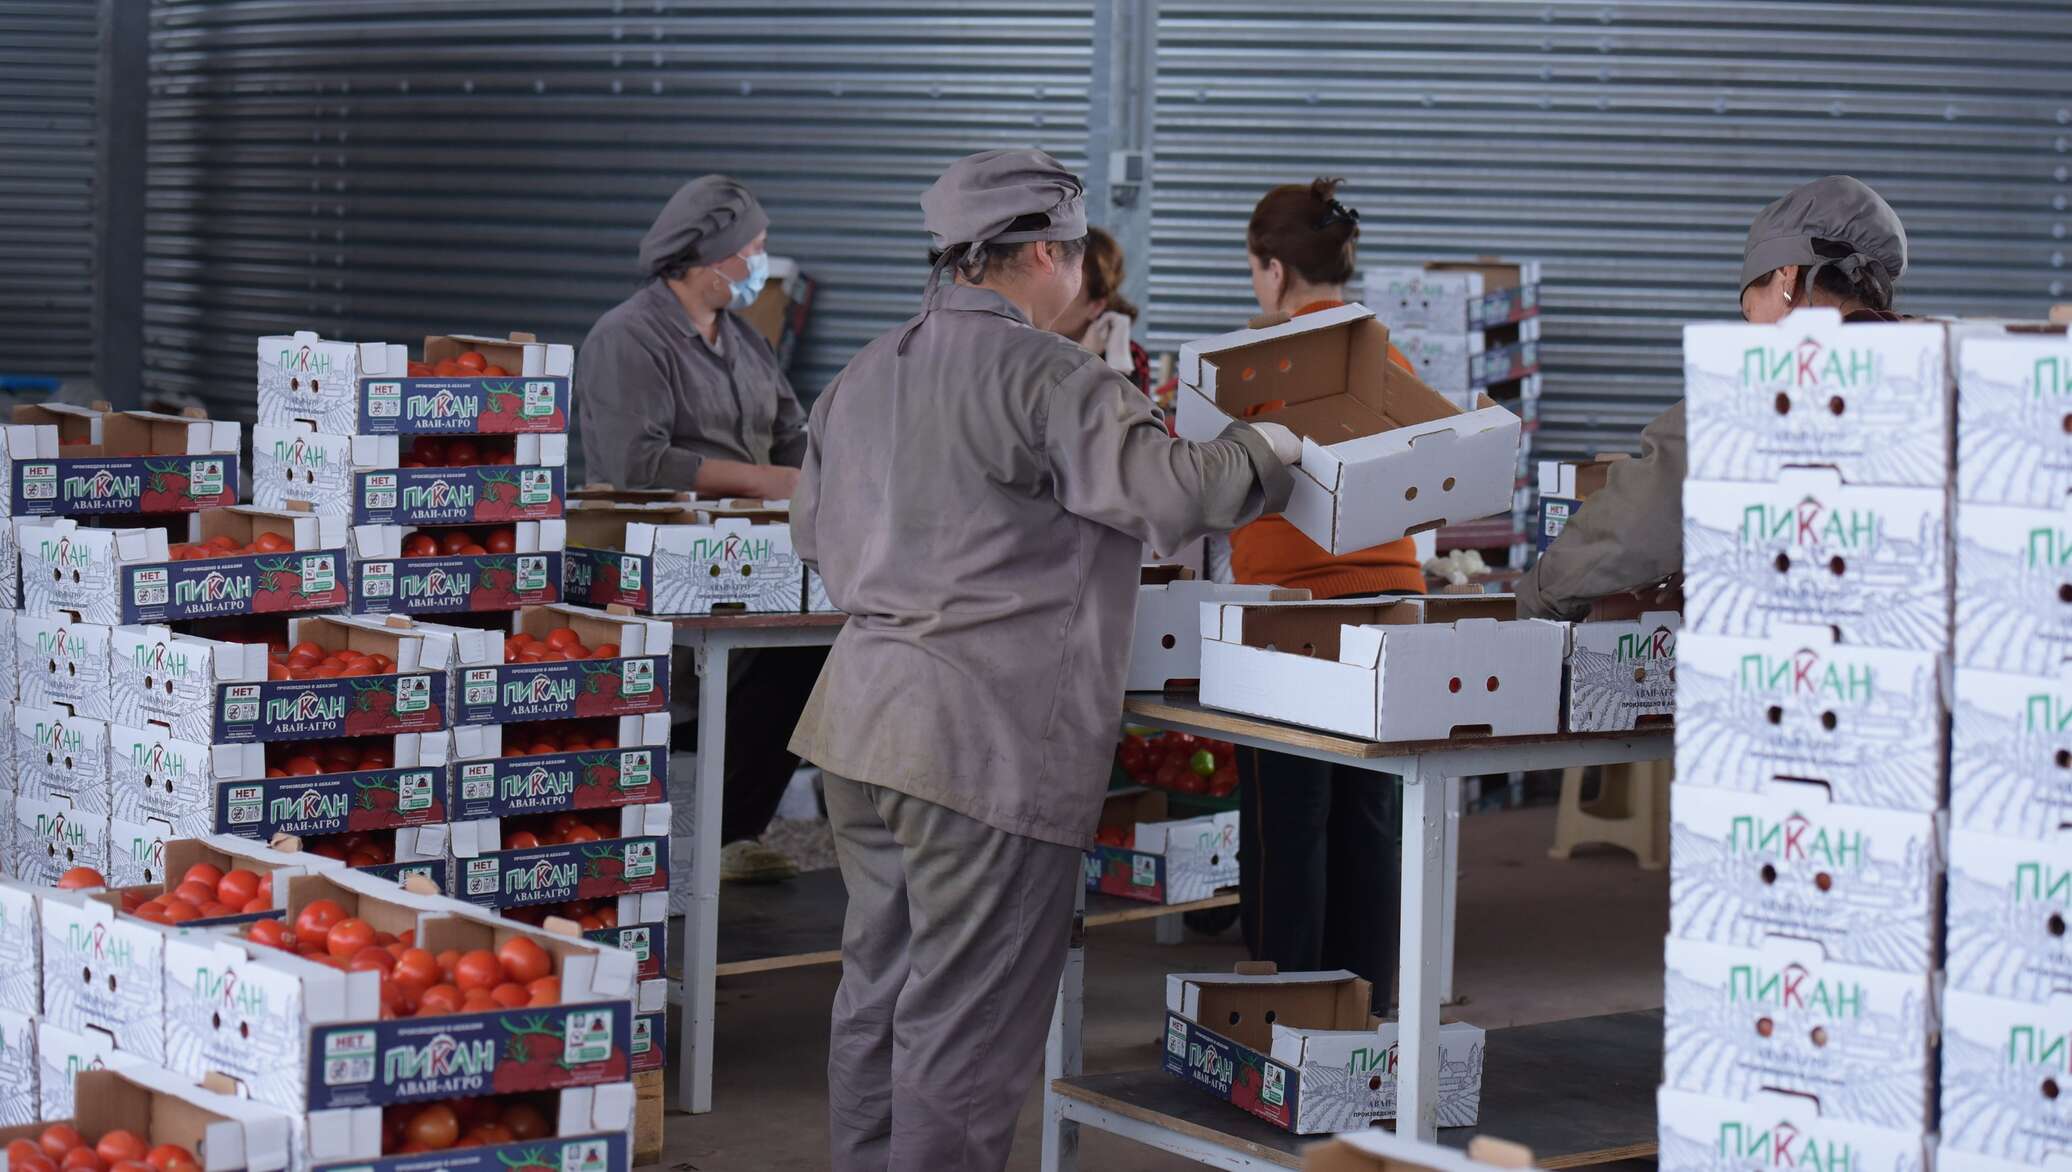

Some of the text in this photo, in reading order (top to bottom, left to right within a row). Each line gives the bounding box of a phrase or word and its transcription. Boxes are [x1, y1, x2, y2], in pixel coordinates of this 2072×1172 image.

[281, 350, 329, 374] ПИКАН
[1743, 348, 1873, 388] ПИКАН
[374, 385, 393, 394] НЕТ
[407, 394, 478, 421] ПИКАН
[275, 441, 323, 465] ПИКАН
[29, 467, 49, 476] НЕТ
[371, 476, 390, 485] НЕТ
[64, 474, 140, 501] ПИКАН
[403, 484, 474, 511] ПИКАН
[1743, 504, 1875, 547] ПИКАН
[41, 539, 89, 567] ПИКАН
[693, 538, 768, 561] ПИКАН
[140, 571, 160, 581] НЕТ
[368, 565, 387, 574] НЕТ
[175, 574, 251, 604] ПИКАН
[400, 572, 470, 600] ПИКАН
[38, 632, 85, 656] ПИКАН
[1618, 632, 1676, 663] ПИК
[136, 645, 186, 676] ПИКАН
[471, 671, 491, 680] НЕТ
[1741, 655, 1872, 699] ПИКАН
[232, 688, 254, 696] НЕТ
[504, 677, 576, 707] ПИКАН
[266, 695, 345, 725] ПИКАН
[36, 723, 81, 747] ПИКАН
[134, 744, 183, 776] ПИКАН
[468, 766, 488, 775] НЕТ
[235, 789, 257, 798] НЕТ
[501, 770, 574, 801] ПИКАН
[270, 792, 348, 825] ПИКАН
[37, 815, 84, 845] ПИКАН
[1198, 829, 1233, 849] ПИК
[1731, 816, 1861, 866] ПИКАН
[132, 838, 163, 868] ПИК
[474, 861, 493, 870] НЕТ
[506, 862, 578, 895] ПИКАН
[68, 924, 132, 963] ПИКАН
[196, 968, 264, 1012] ПИКАН
[1730, 966, 1861, 1018] ПИКАН
[336, 1035, 365, 1048] НЕТ
[384, 1038, 495, 1085] ПИКАН
[1188, 1042, 1234, 1085] ПИКАН
[1350, 1048, 1398, 1076] ПИК
[1720, 1121, 1853, 1172] ПИКАН
